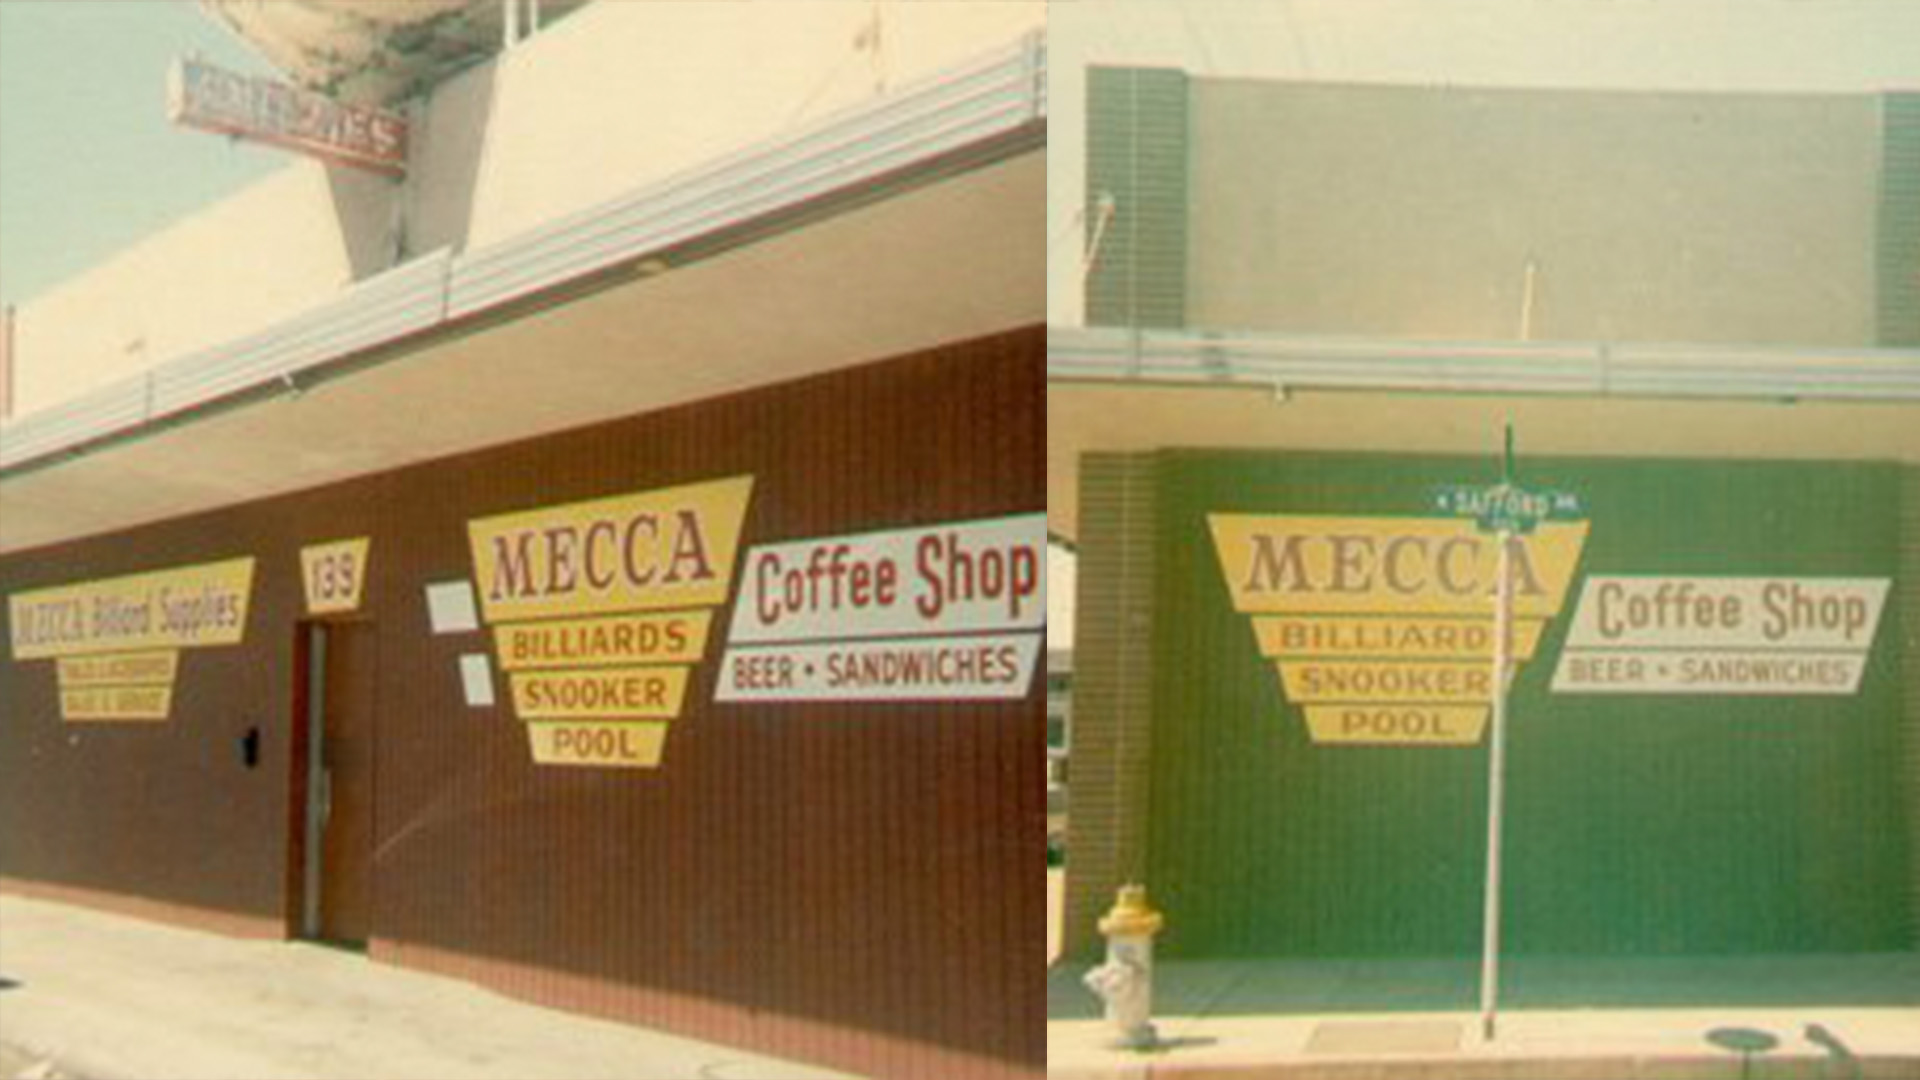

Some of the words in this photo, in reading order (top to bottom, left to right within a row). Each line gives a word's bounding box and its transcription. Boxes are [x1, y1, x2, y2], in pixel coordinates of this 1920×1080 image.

[312, 554, 355, 599] 139
[489, 509, 716, 601] MECCA
[1242, 532, 1548, 597] MECCA
[757, 545, 896, 625] Coffee
[916, 533, 1038, 620] Shop
[158, 579, 240, 638] Supplies
[1598, 581, 1743, 639] Coffee
[1762, 581, 1867, 641] Shop
[512, 619, 688, 661] BILLIARDS
[1281, 622, 1500, 650] BILLIARD
[733, 655, 793, 690] BEER
[826, 646, 1019, 687] SANDWICHES
[1301, 667, 1492, 694] SNOOKER
[1568, 658, 1645, 683] BEER
[1680, 658, 1852, 685] SANDWICHES
[524, 677, 668, 711] SNOOKER
[552, 726, 638, 760] POOL
[1340, 709, 1456, 737] POOL
